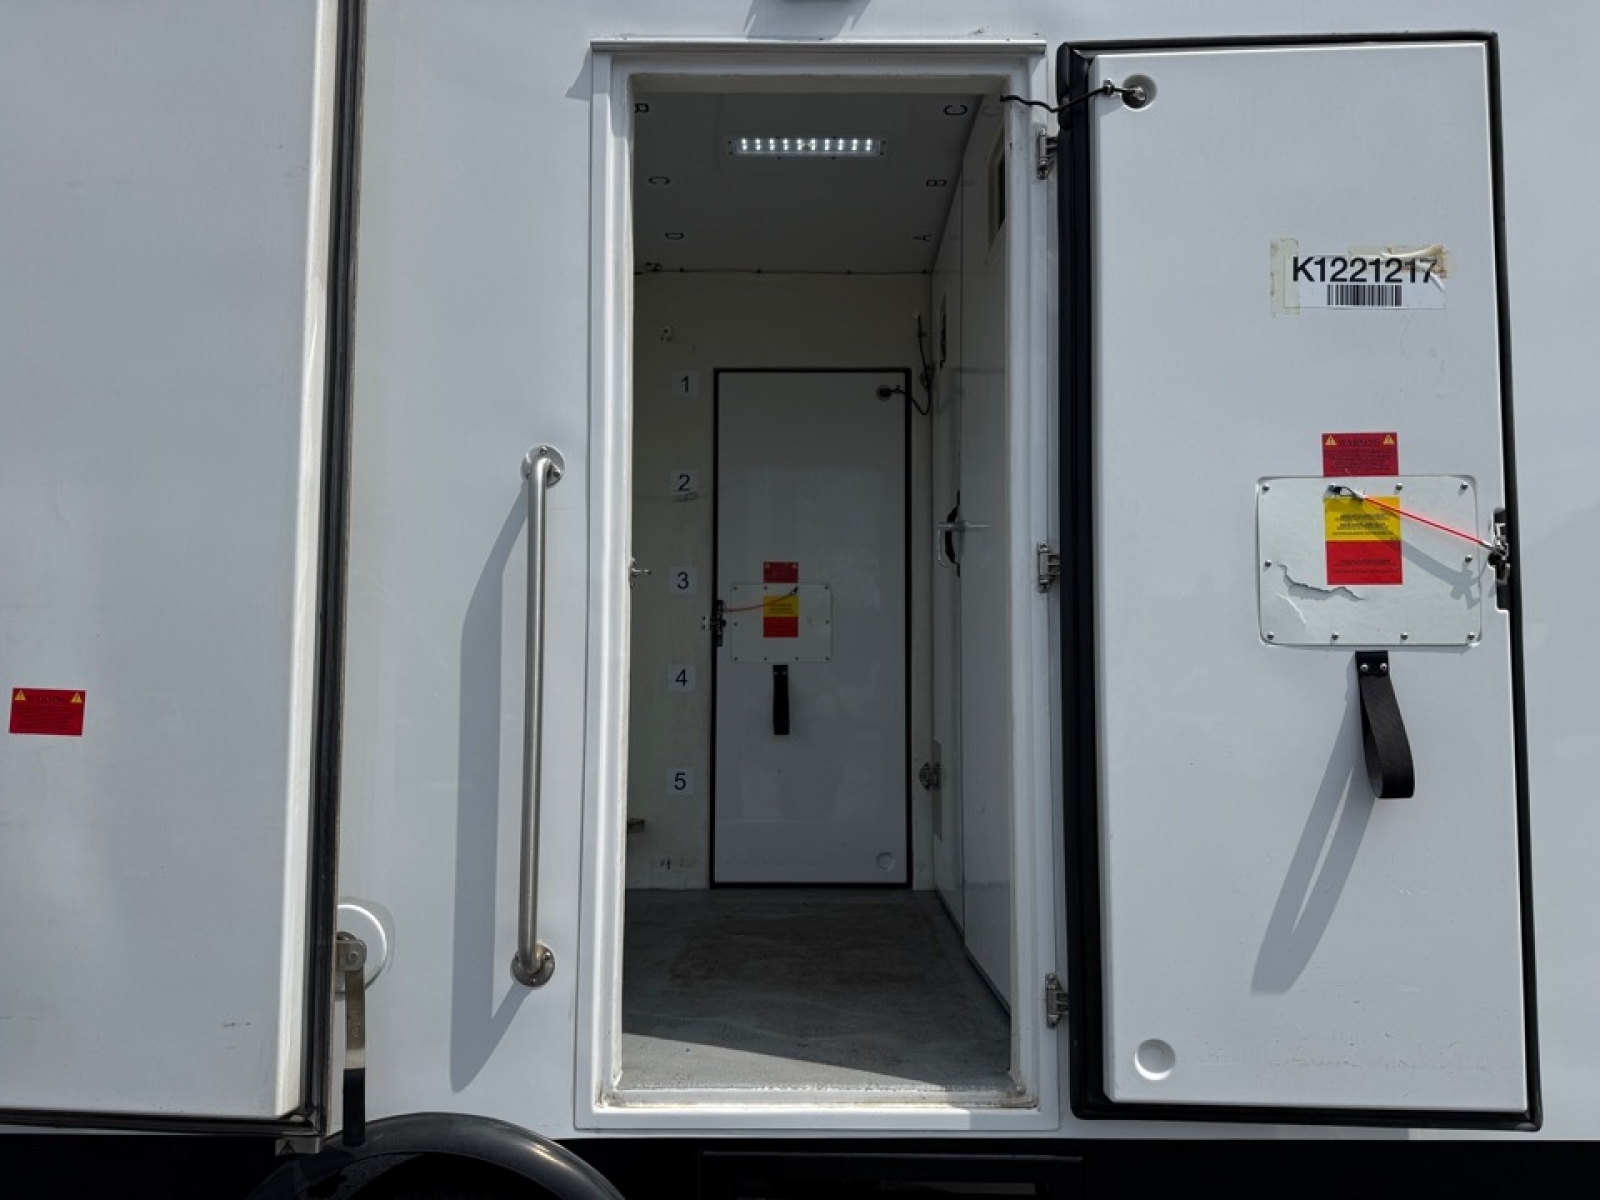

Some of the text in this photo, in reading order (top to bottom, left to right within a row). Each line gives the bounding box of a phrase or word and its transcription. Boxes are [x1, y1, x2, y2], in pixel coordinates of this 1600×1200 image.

[942, 104, 968, 117] C
[648, 176, 671, 186] C
[925, 179, 948, 188] B
[664, 231, 685, 240] D
[913, 233, 932, 242] A
[1292, 256, 1438, 283] K1221217
[680, 375, 690, 393] 1
[677, 474, 691, 491] 2
[676, 571, 689, 590] 3
[674, 669, 688, 687] 4
[674, 772, 687, 790] 5
